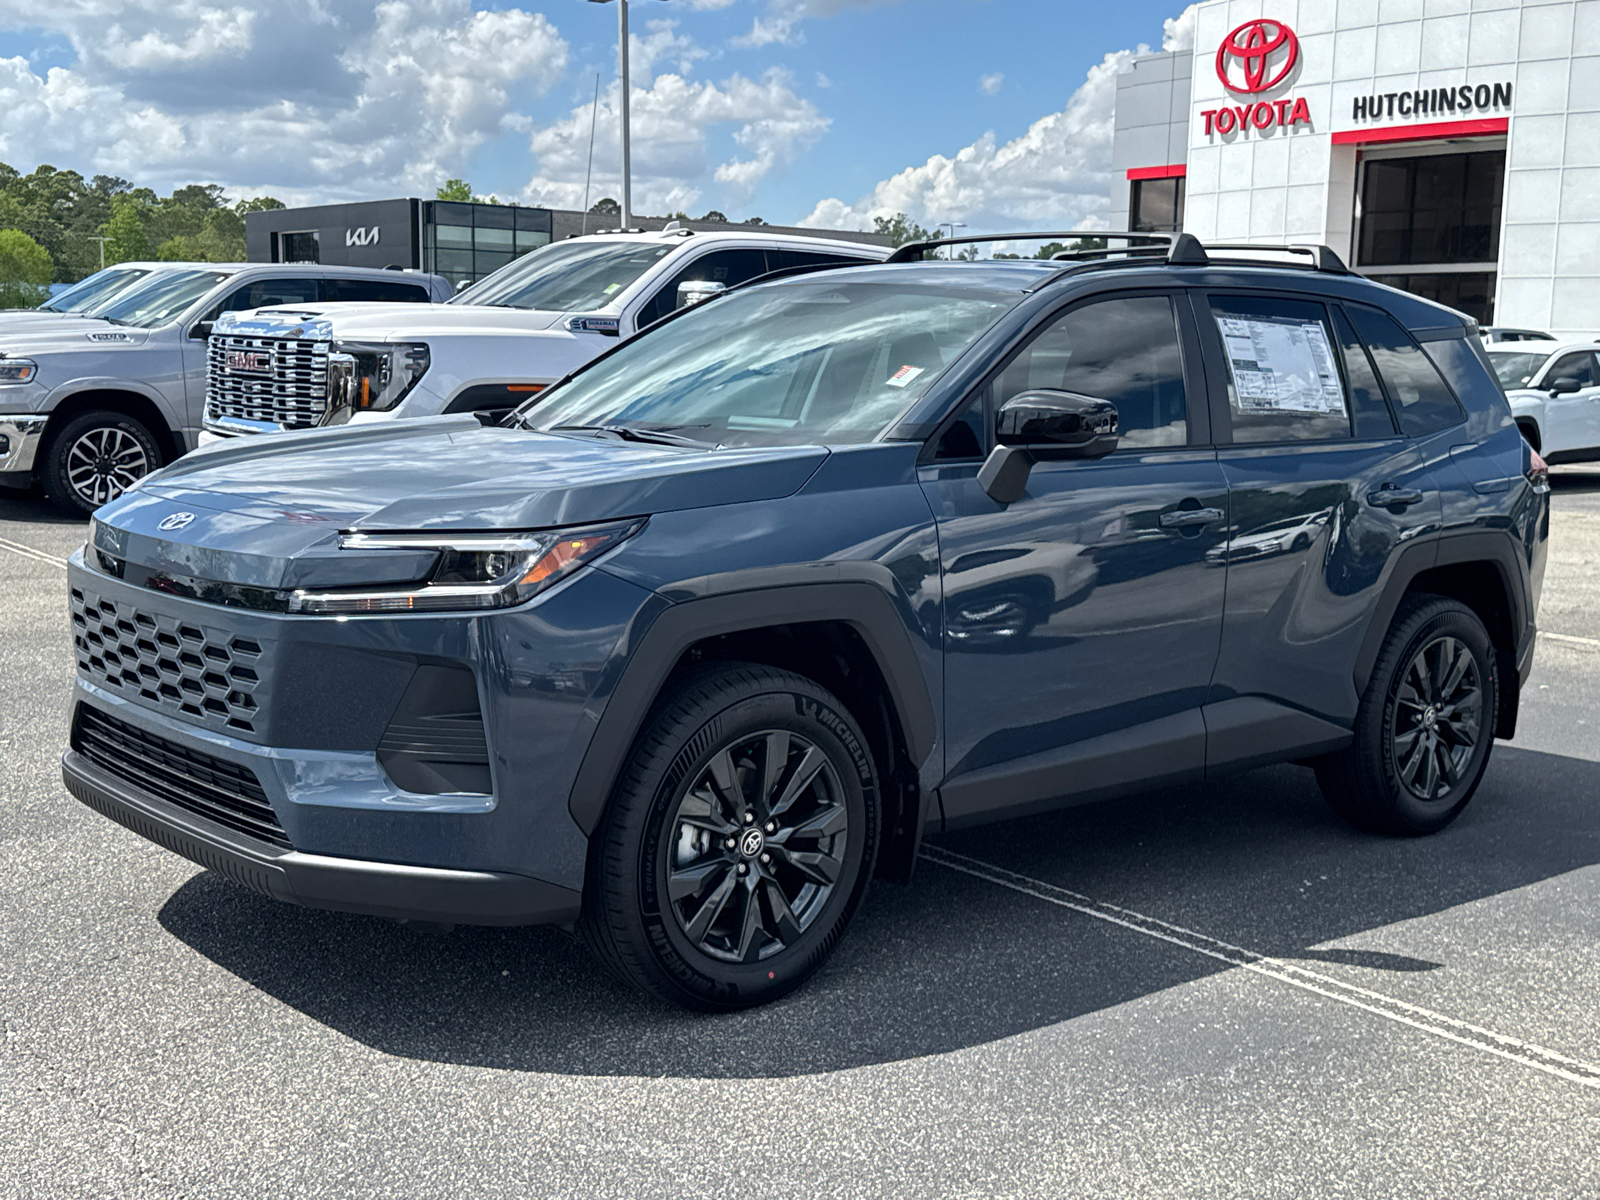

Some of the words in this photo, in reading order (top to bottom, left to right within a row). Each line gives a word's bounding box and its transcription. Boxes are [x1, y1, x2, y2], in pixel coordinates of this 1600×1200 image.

[1200, 97, 1310, 136] TOYOTA
[1353, 82, 1512, 120] HUTCHINSON
[346, 226, 379, 247] KIA
[226, 351, 270, 371] GMC
[818, 707, 871, 780] MICHELIN
[646, 838, 656, 893] PRIMACY
[648, 923, 713, 994] MICHELIN
